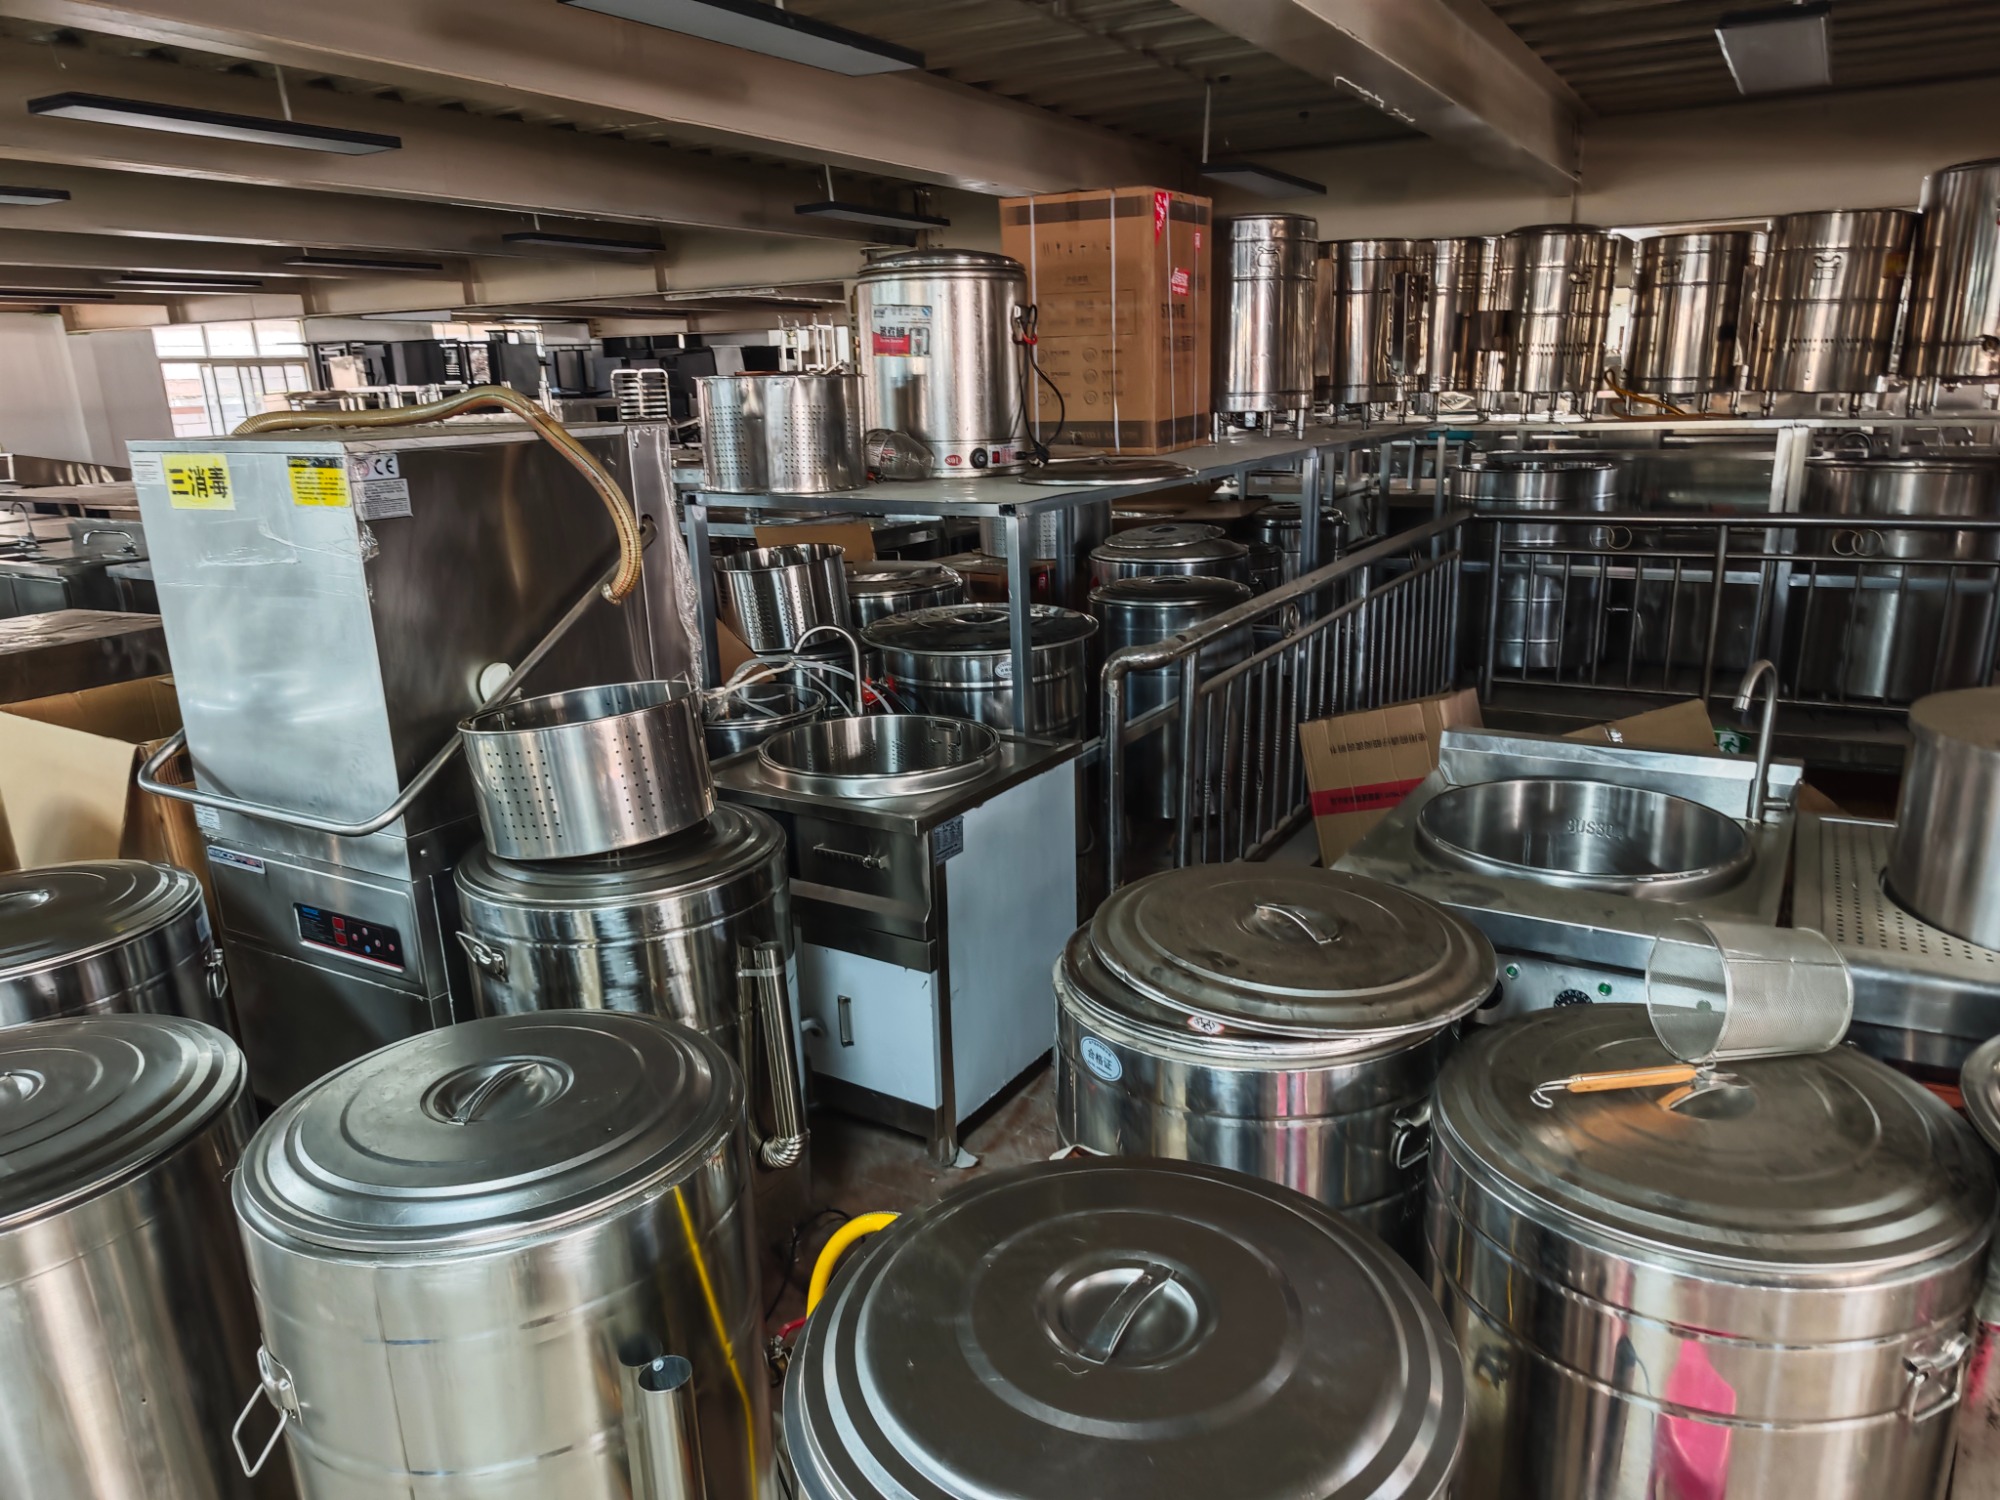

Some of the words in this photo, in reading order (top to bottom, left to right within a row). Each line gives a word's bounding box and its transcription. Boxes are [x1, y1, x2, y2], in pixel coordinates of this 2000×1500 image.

[168, 466, 229, 498] 三消毒
[1088, 1048, 1113, 1072] 合格证
